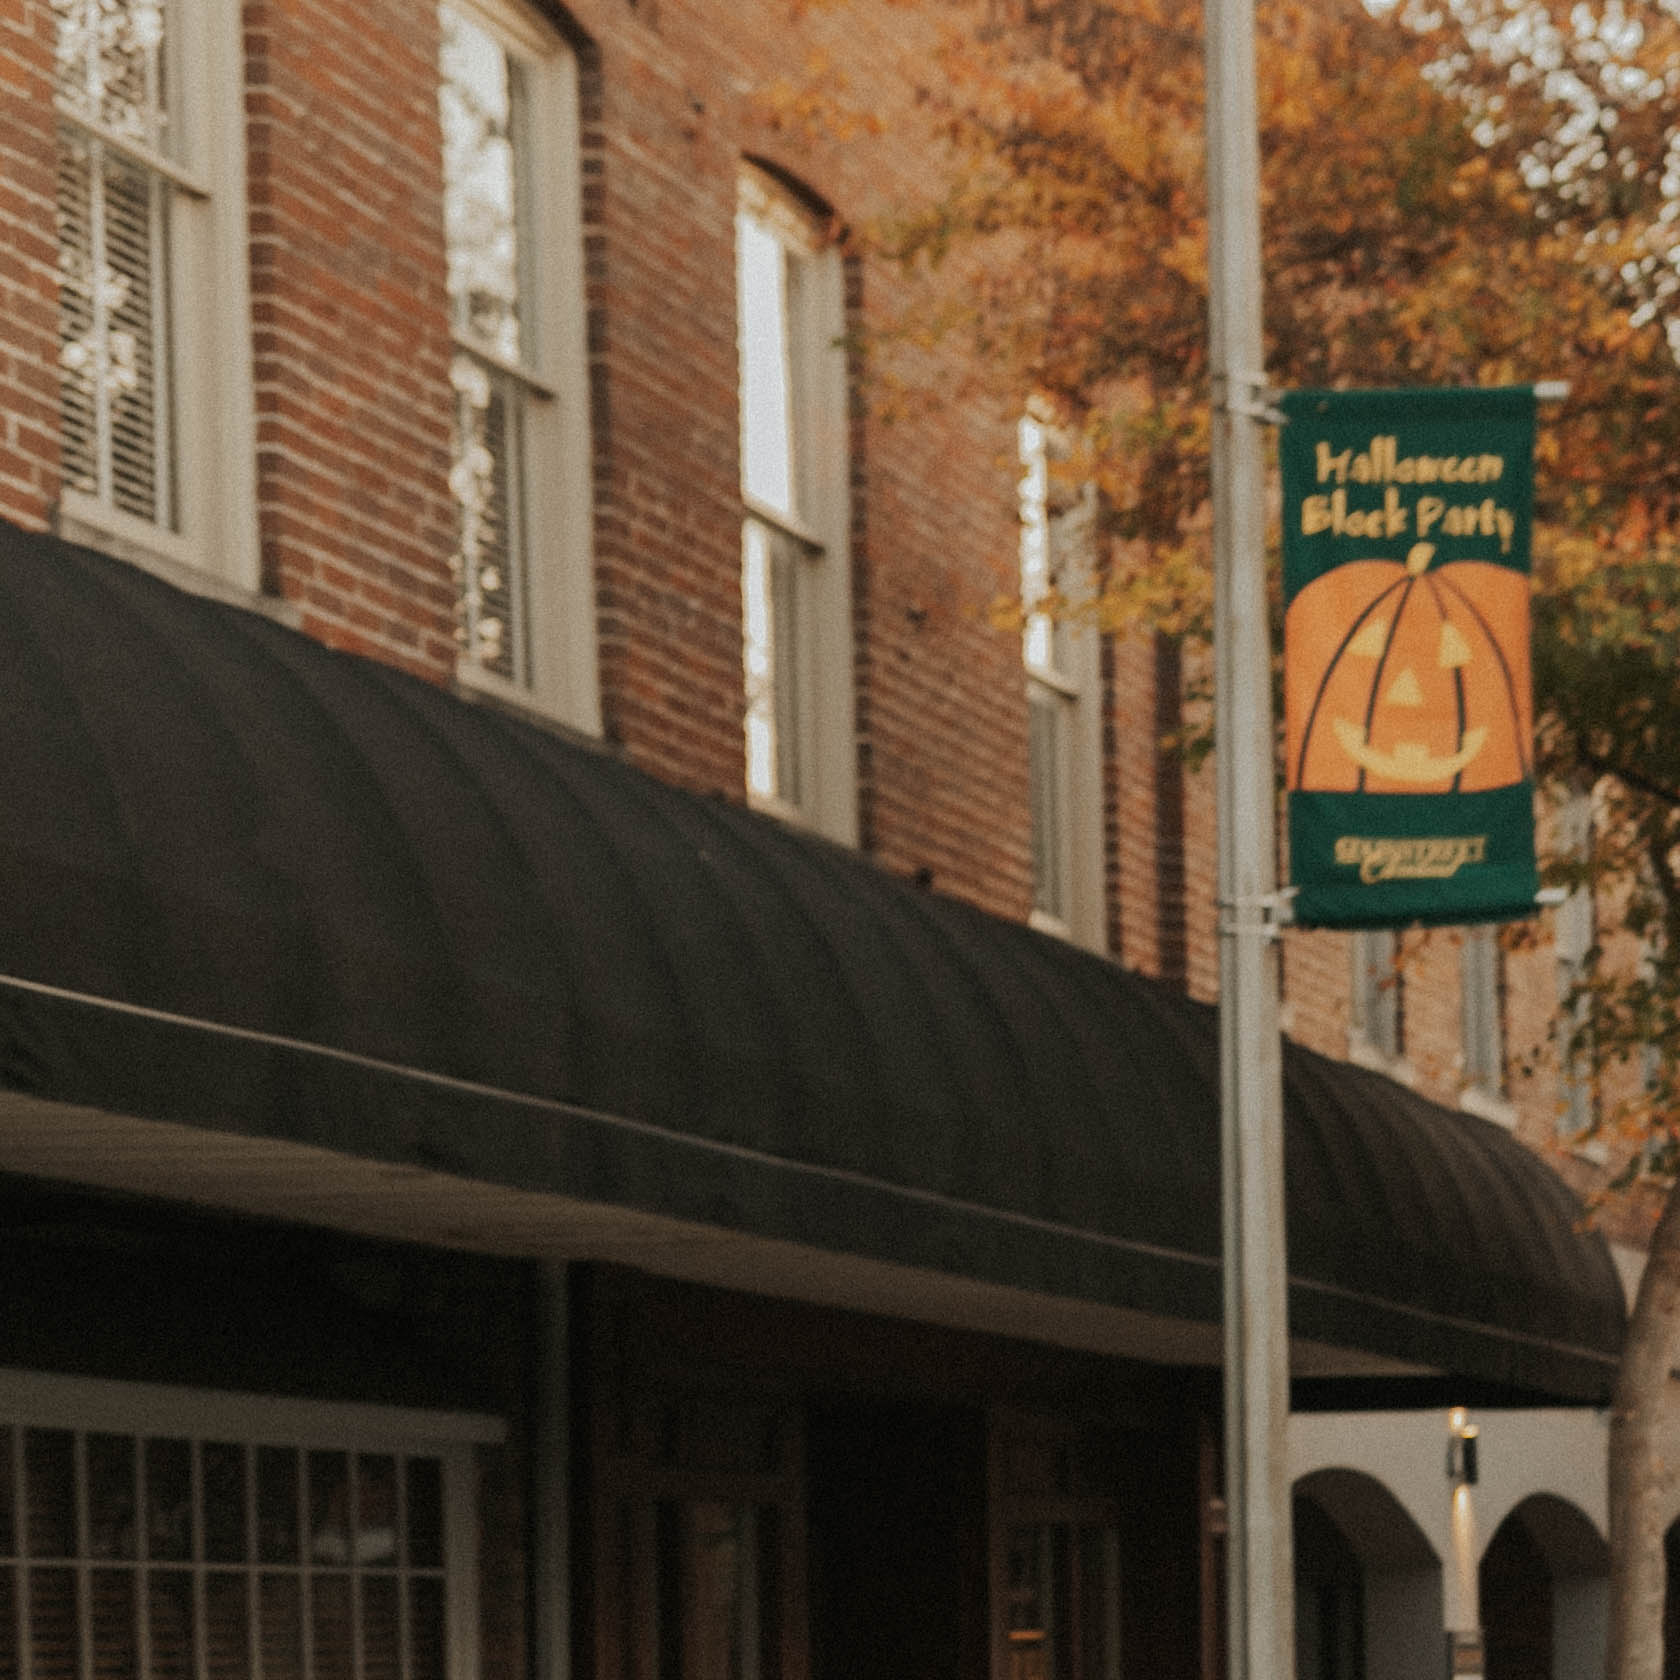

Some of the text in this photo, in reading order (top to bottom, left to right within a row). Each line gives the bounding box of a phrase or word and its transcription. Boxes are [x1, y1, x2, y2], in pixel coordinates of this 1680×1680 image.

[1316, 435, 1503, 484] Halloween
[1302, 486, 1514, 554] Block Party
